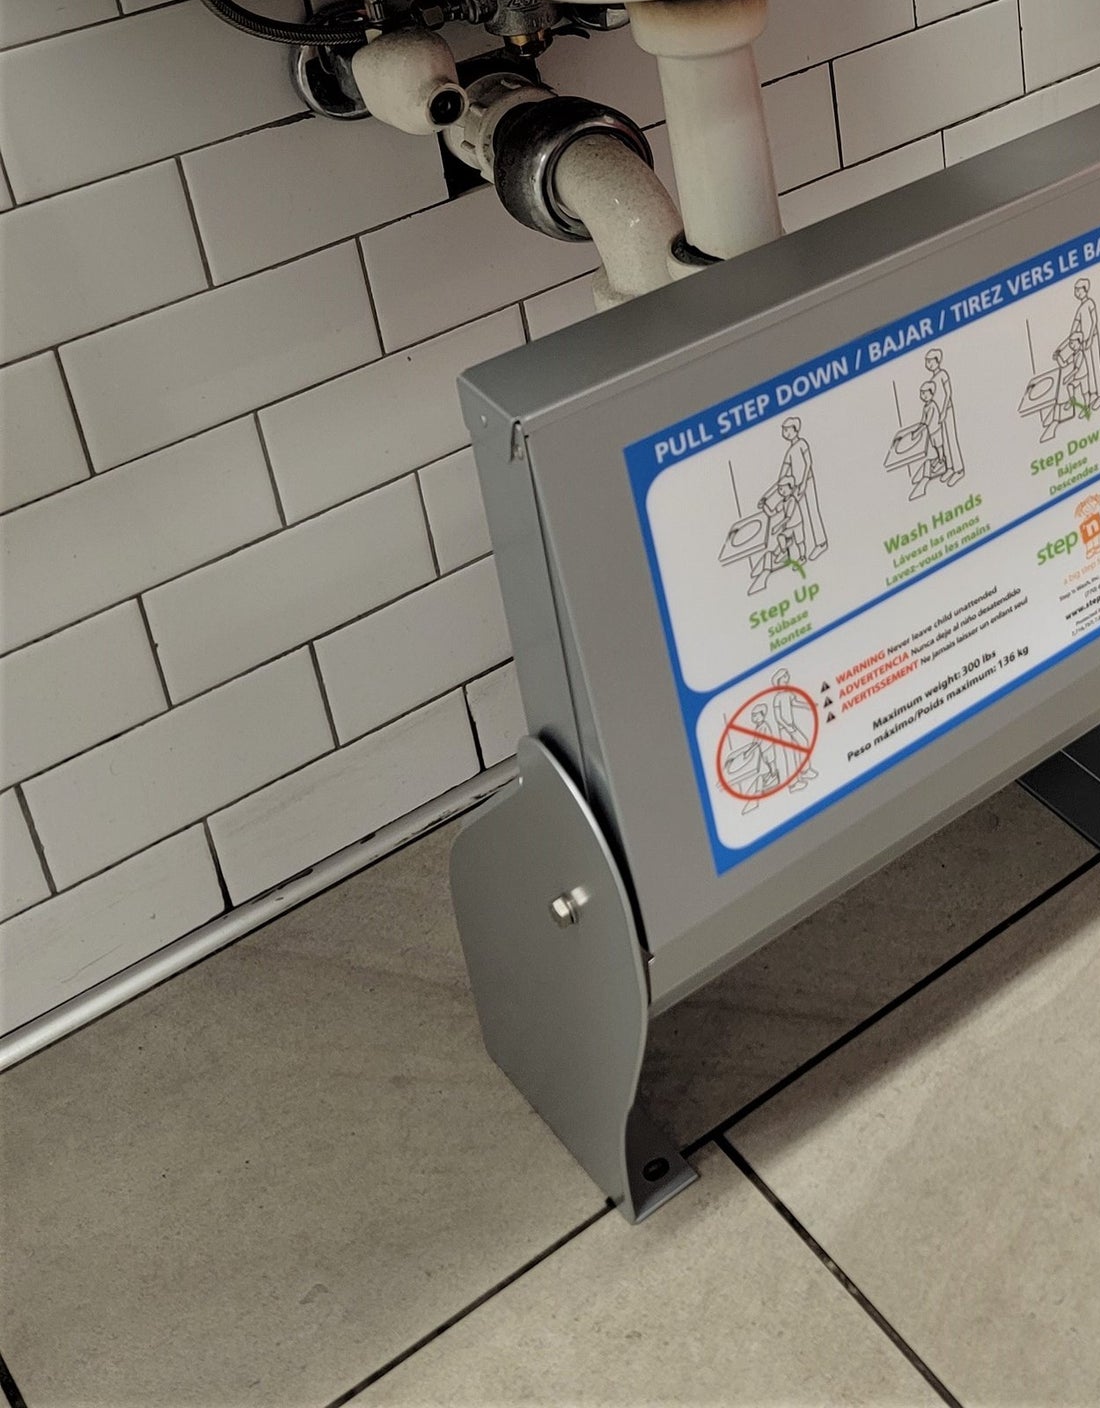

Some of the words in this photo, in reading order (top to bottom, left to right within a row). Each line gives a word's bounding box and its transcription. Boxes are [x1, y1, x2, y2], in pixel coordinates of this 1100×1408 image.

[654, 423, 713, 464] PULL
[717, 394, 770, 434] STEP
[775, 356, 849, 406] DOWN
[855, 349, 862, 371] /
[867, 317, 933, 363] BAJAR
[938, 310, 946, 331] /
[950, 283, 1004, 322] TIREZ
[1007, 261, 1055, 296] VERS
[1058, 249, 1080, 273] LE
[1030, 450, 1064, 476] Step
[1049, 464, 1099, 496] Descendez
[1057, 457, 1088, 478] Bájese
[883, 522, 929, 555] Wash
[931, 492, 983, 530] Hands
[892, 542, 930, 569] Lávese
[930, 533, 946, 548] las
[946, 516, 980, 541] manos
[1036, 530, 1079, 566] step
[885, 551, 944, 587] Lavez-vous
[944, 541, 960, 555] les
[960, 523, 991, 548] mains
[748, 598, 791, 629] Step
[793, 583, 820, 605] Up
[767, 610, 809, 638] Súbase
[835, 650, 886, 684] WARNING
[886, 637, 910, 656] Never
[911, 624, 932, 641] leave
[934, 611, 952, 629] child
[953, 586, 997, 616] unattended
[770, 622, 813, 652] Montez
[838, 652, 909, 699] ADVERTENCIA
[910, 639, 935, 656] Nunca
[936, 628, 951, 643] deje
[953, 620, 959, 632] al
[960, 614, 976, 628] niño
[977, 587, 1021, 617] desatendido
[840, 659, 919, 713] AVERTISSEMENT
[920, 654, 932, 666] Ne
[931, 639, 956, 661] jamais
[956, 626, 978, 644] laisser
[979, 620, 990, 631] un
[990, 607, 1013, 625] enfant
[1014, 596, 1028, 611] seul
[847, 742, 872, 762] Peso
[873, 697, 944, 746] máximo/Poids
[946, 665, 997, 702] maximum:
[997, 651, 1016, 669] 136
[1016, 645, 1029, 659] kg
[872, 693, 923, 731] Maximum
[924, 670, 962, 698] weight:
[962, 658, 980, 677] 300
[981, 649, 996, 664] lbs
